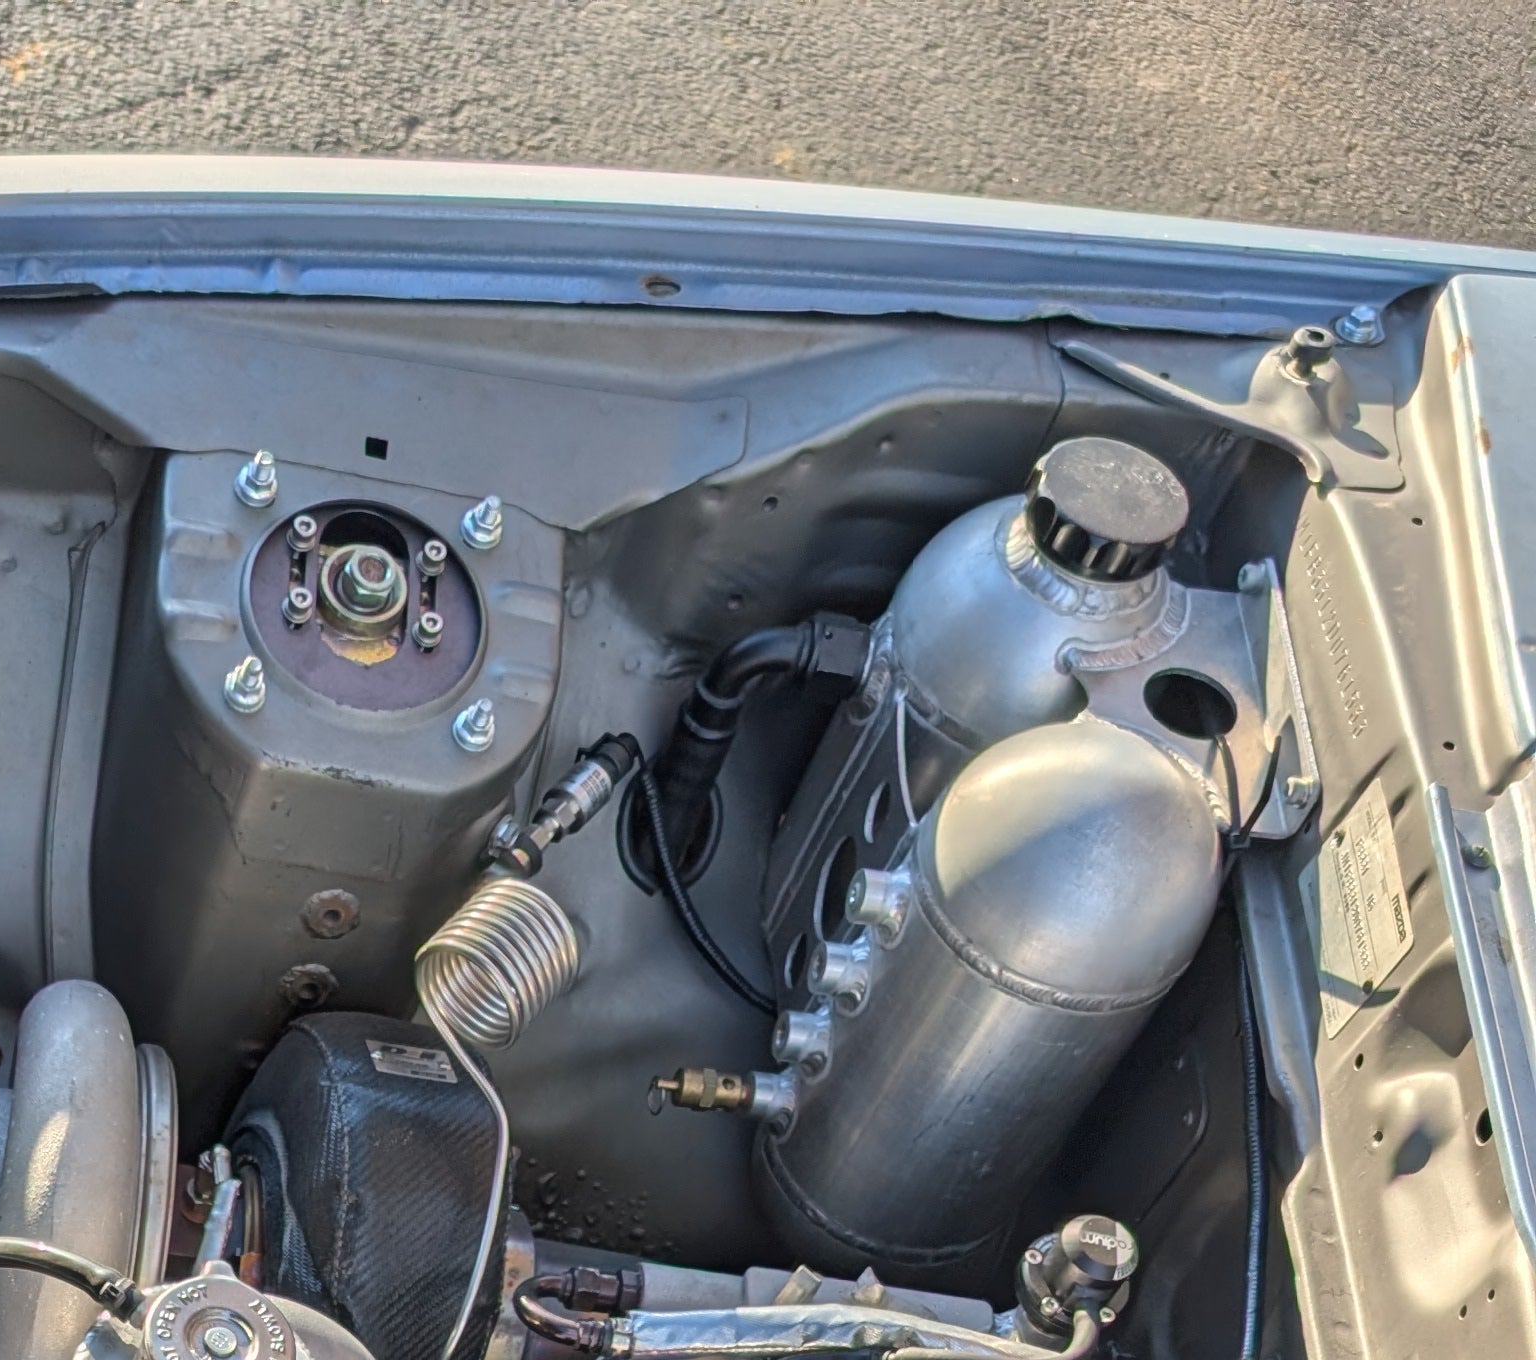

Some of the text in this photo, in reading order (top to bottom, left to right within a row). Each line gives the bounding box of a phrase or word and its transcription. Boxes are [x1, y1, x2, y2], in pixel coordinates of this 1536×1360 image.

[1392, 893, 1406, 944] mazda
[156, 1301, 182, 1339] OPEN
[177, 1284, 207, 1306] HOT
[248, 1299, 285, 1354] SLOWLY
